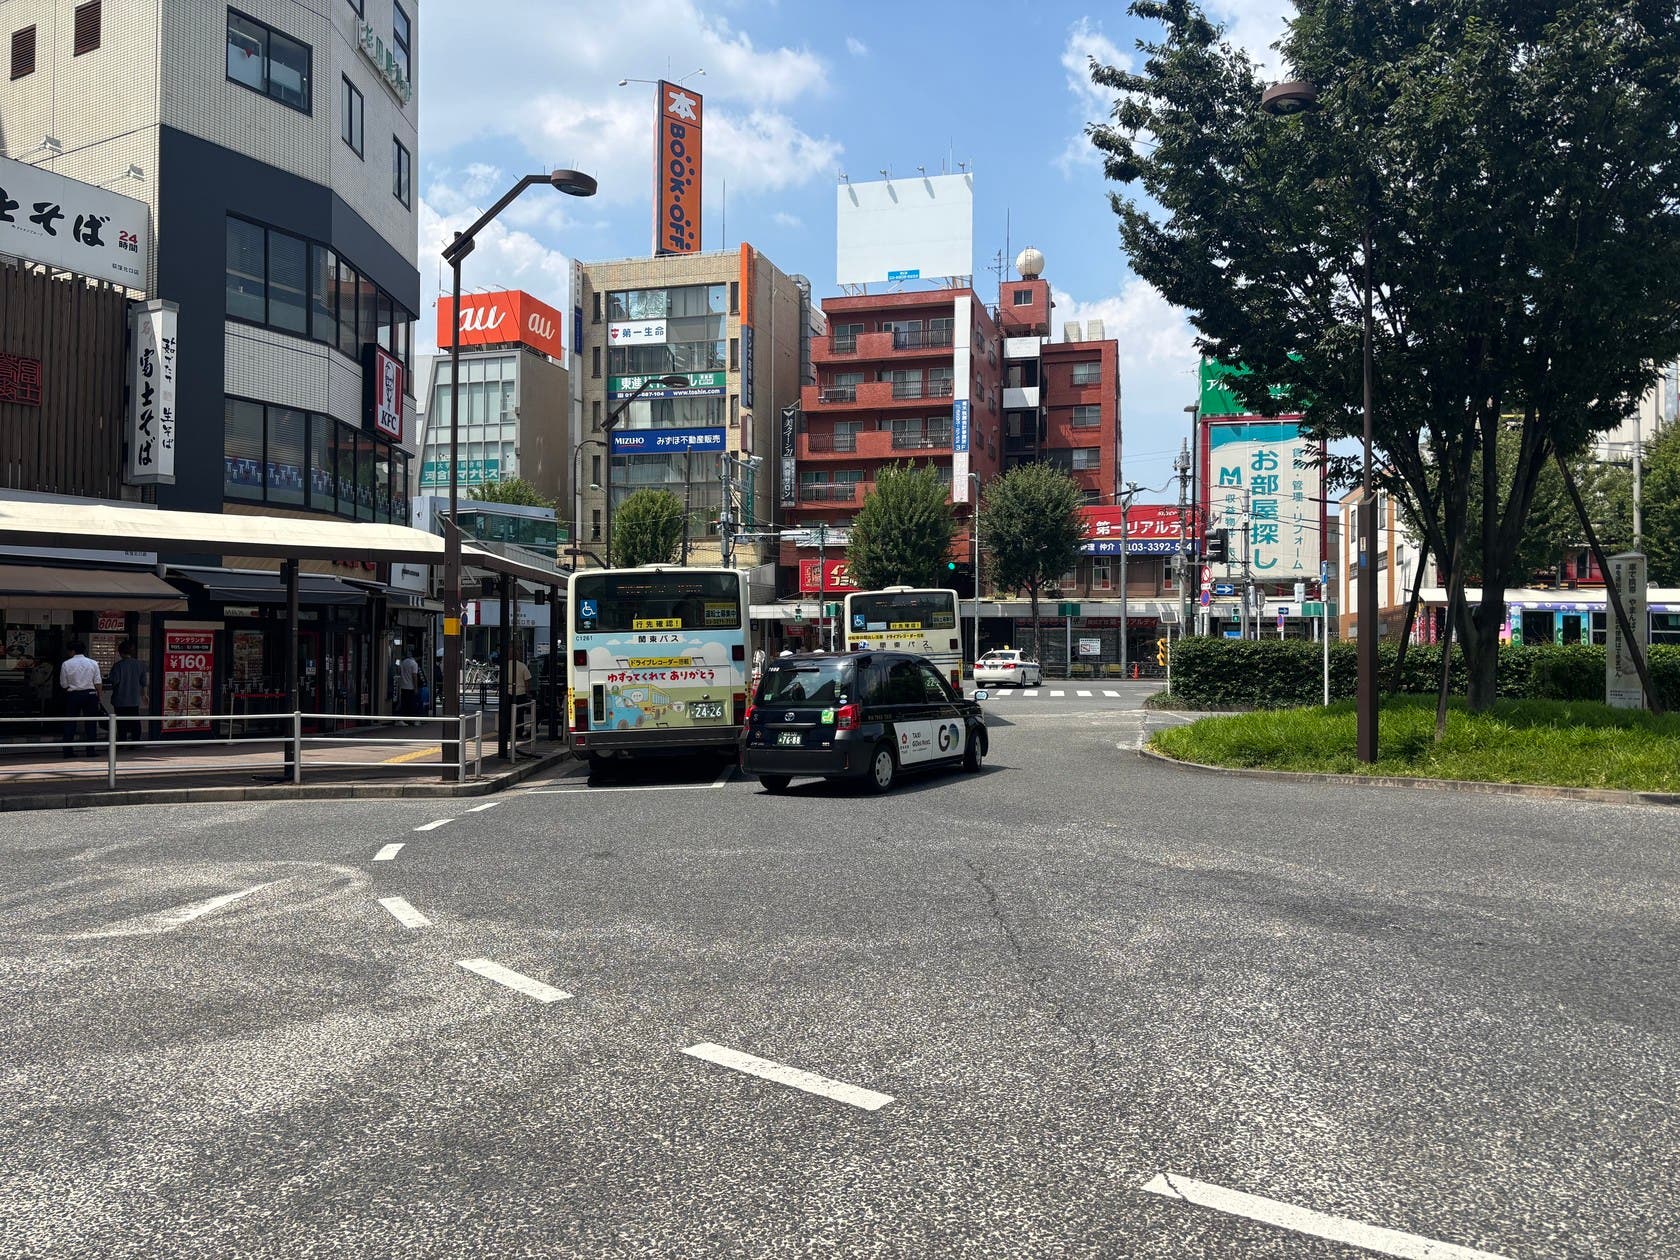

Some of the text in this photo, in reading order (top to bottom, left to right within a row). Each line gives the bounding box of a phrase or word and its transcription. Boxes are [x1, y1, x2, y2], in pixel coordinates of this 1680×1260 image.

[668, 92, 696, 121] 本
[119, 230, 138, 245] 24
[118, 240, 138, 253] 時間
[459, 305, 506, 333] au
[528, 312, 556, 341] au
[622, 326, 664, 338] 第一生命
[138, 348, 156, 466] 富士そば
[380, 410, 398, 432] KFC
[614, 437, 645, 445] MIZUHO
[656, 434, 721, 446] みずほ不動産販売
[424, 467, 499, 481] 河合マナビス
[1250, 449, 1280, 570] お部屋探し
[1099, 542, 1116, 551] 仲介
[829, 575, 858, 587] コミッ
[638, 635, 680, 644] 関東バス
[630, 658, 691, 668] ドライブレコーダー搭載
[607, 669, 716, 683] ゆずってくれて ありがとう
[938, 723, 960, 752] GO
